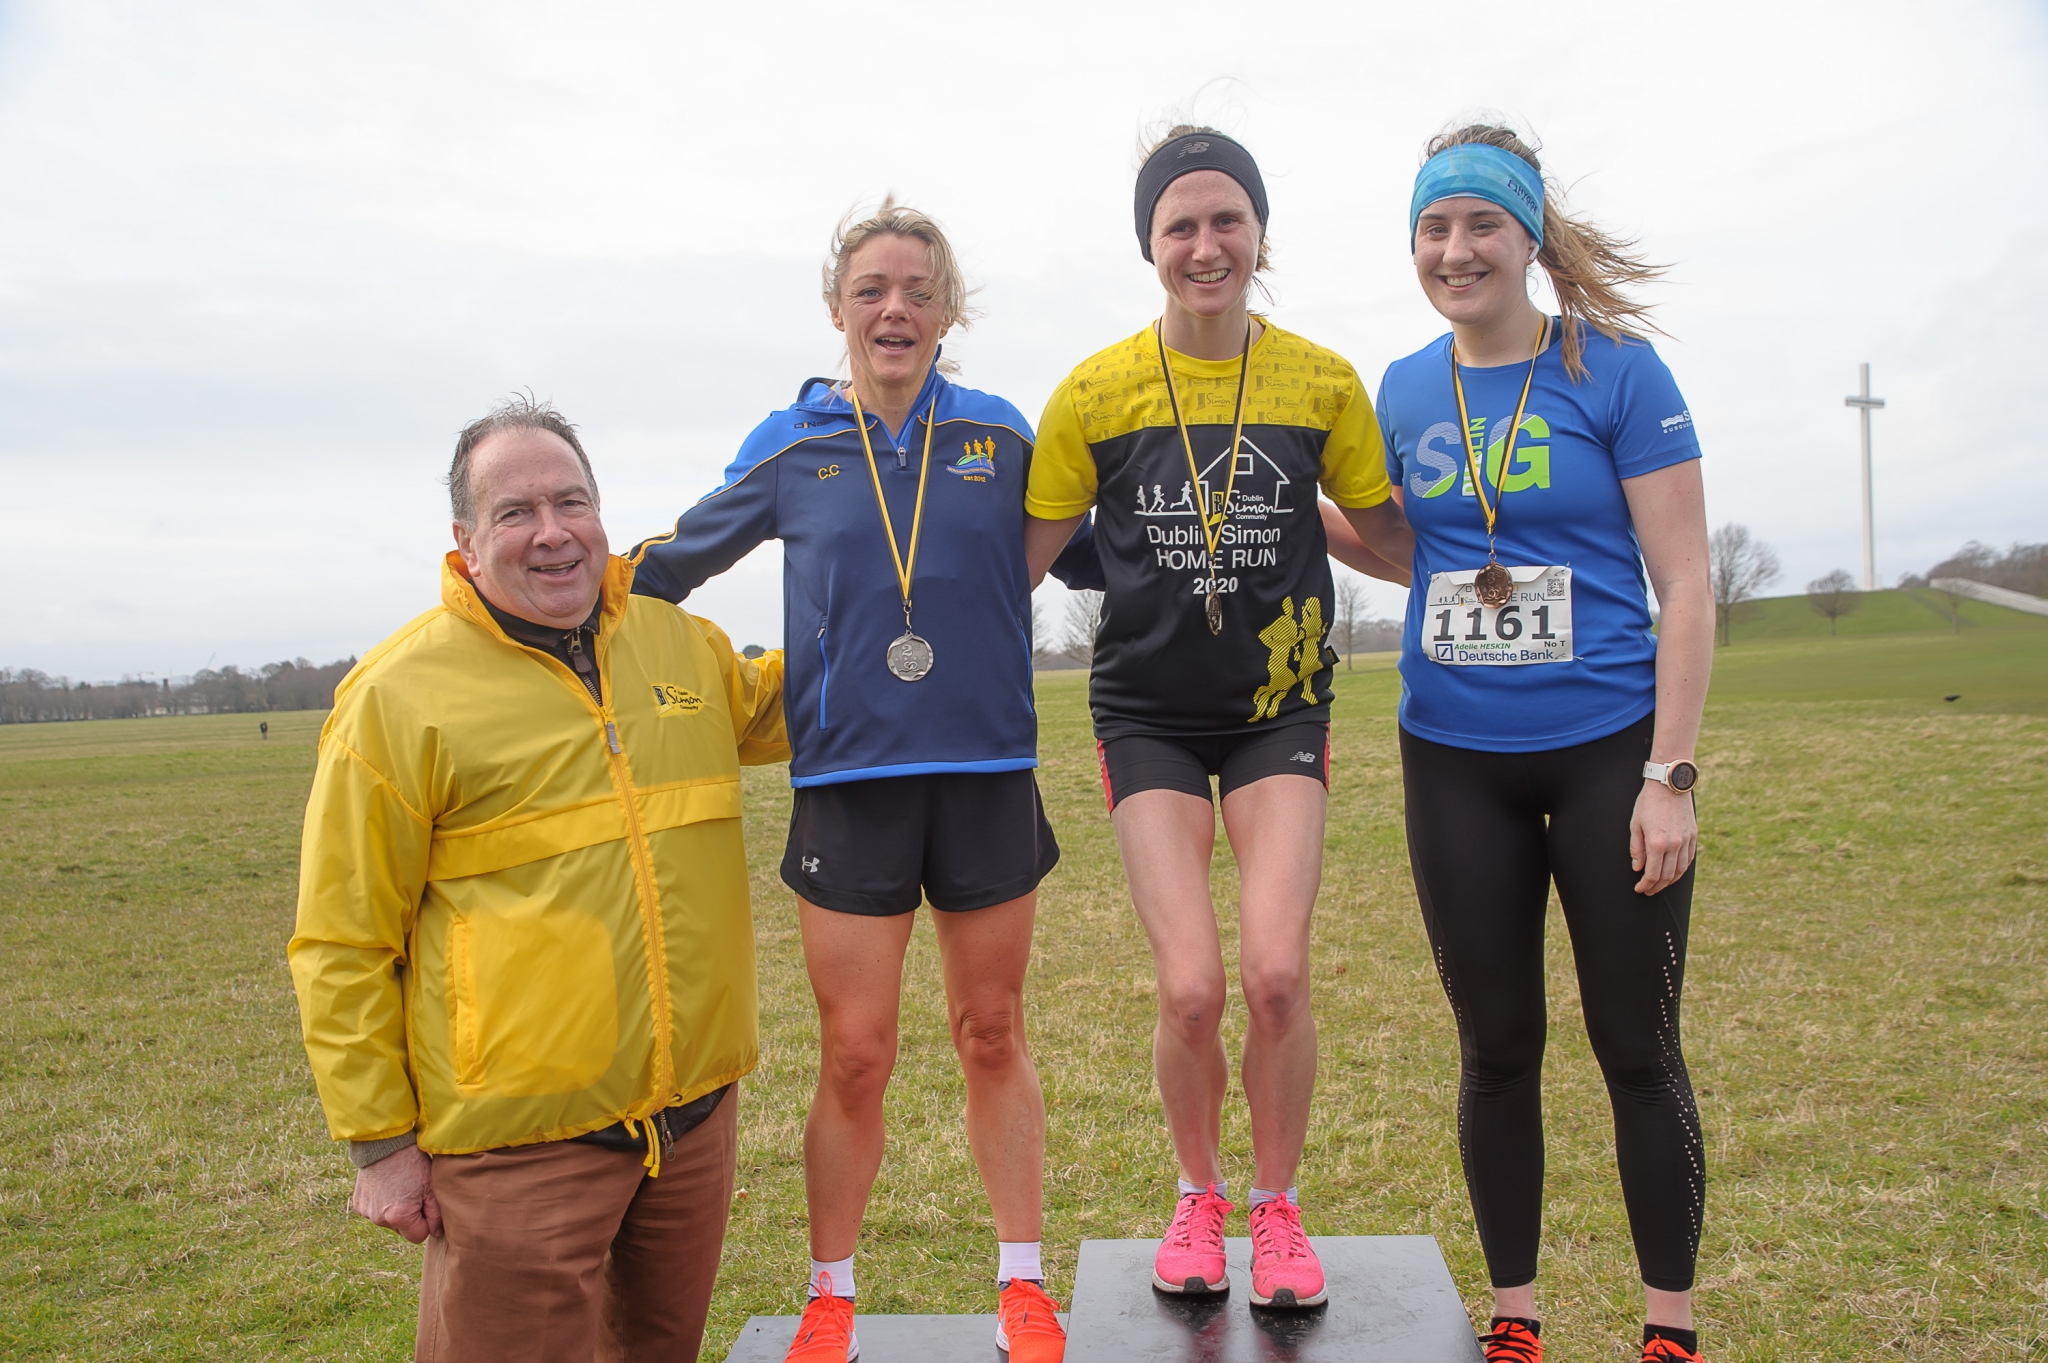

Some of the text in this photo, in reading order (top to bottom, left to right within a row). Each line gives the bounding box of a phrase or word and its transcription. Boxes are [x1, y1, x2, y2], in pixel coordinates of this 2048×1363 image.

[1206, 393, 1231, 404] Simon
[1227, 490, 1274, 514] Simon
[1220, 524, 1281, 545] Simon
[1156, 548, 1276, 570] HOME RUN
[1193, 577, 1238, 594] 2020
[1521, 593, 1544, 602] RUN
[1433, 605, 1556, 642] 1161
[1480, 642, 1511, 650] HESKIN
[1459, 649, 1554, 662] Deutsche Bank
[666, 685, 703, 704] Simon
